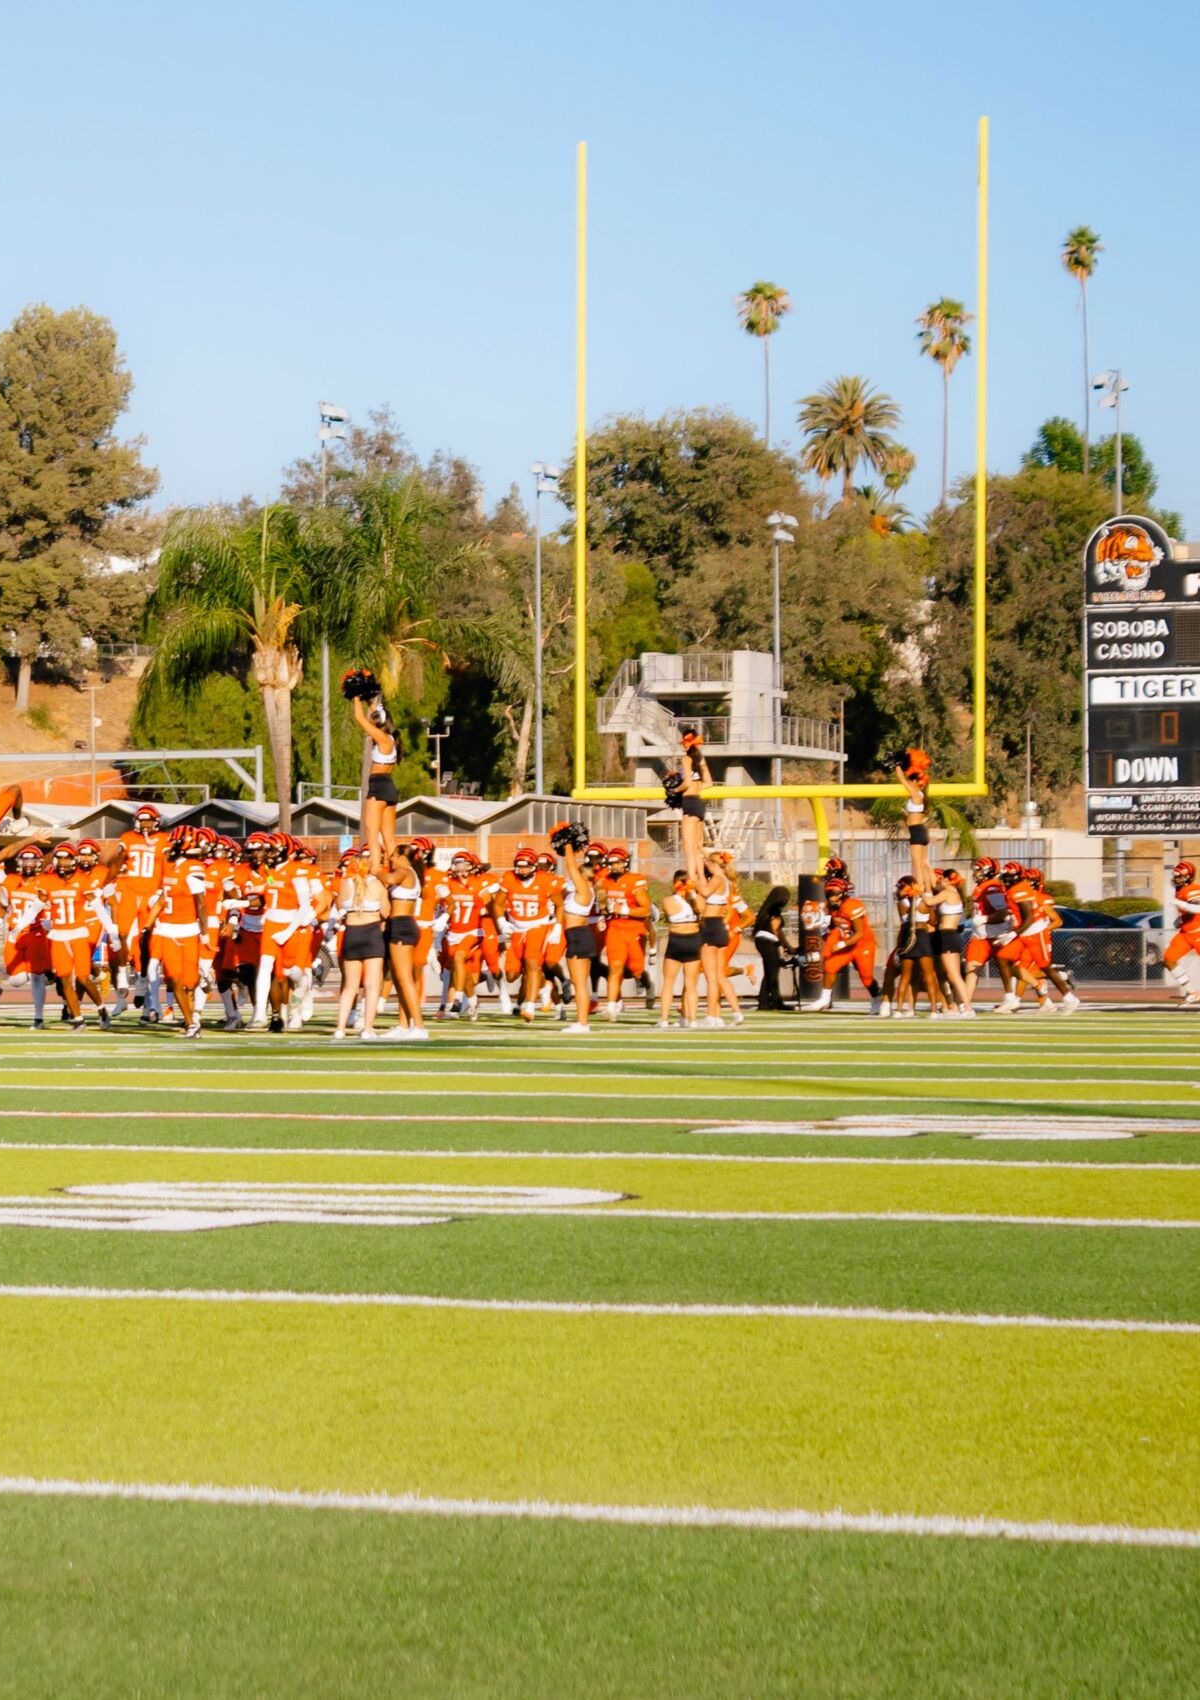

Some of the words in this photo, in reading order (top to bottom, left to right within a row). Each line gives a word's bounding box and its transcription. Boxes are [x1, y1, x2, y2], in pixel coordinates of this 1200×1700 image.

[1092, 619, 1169, 638] SOBOBA
[1097, 641, 1165, 659] CASINO
[1115, 679, 1196, 698] TIGER
[1116, 756, 1178, 784] DOWN
[1141, 794, 1174, 804] UNITED
[128, 851, 155, 878] 30
[53, 898, 75, 924] 31
